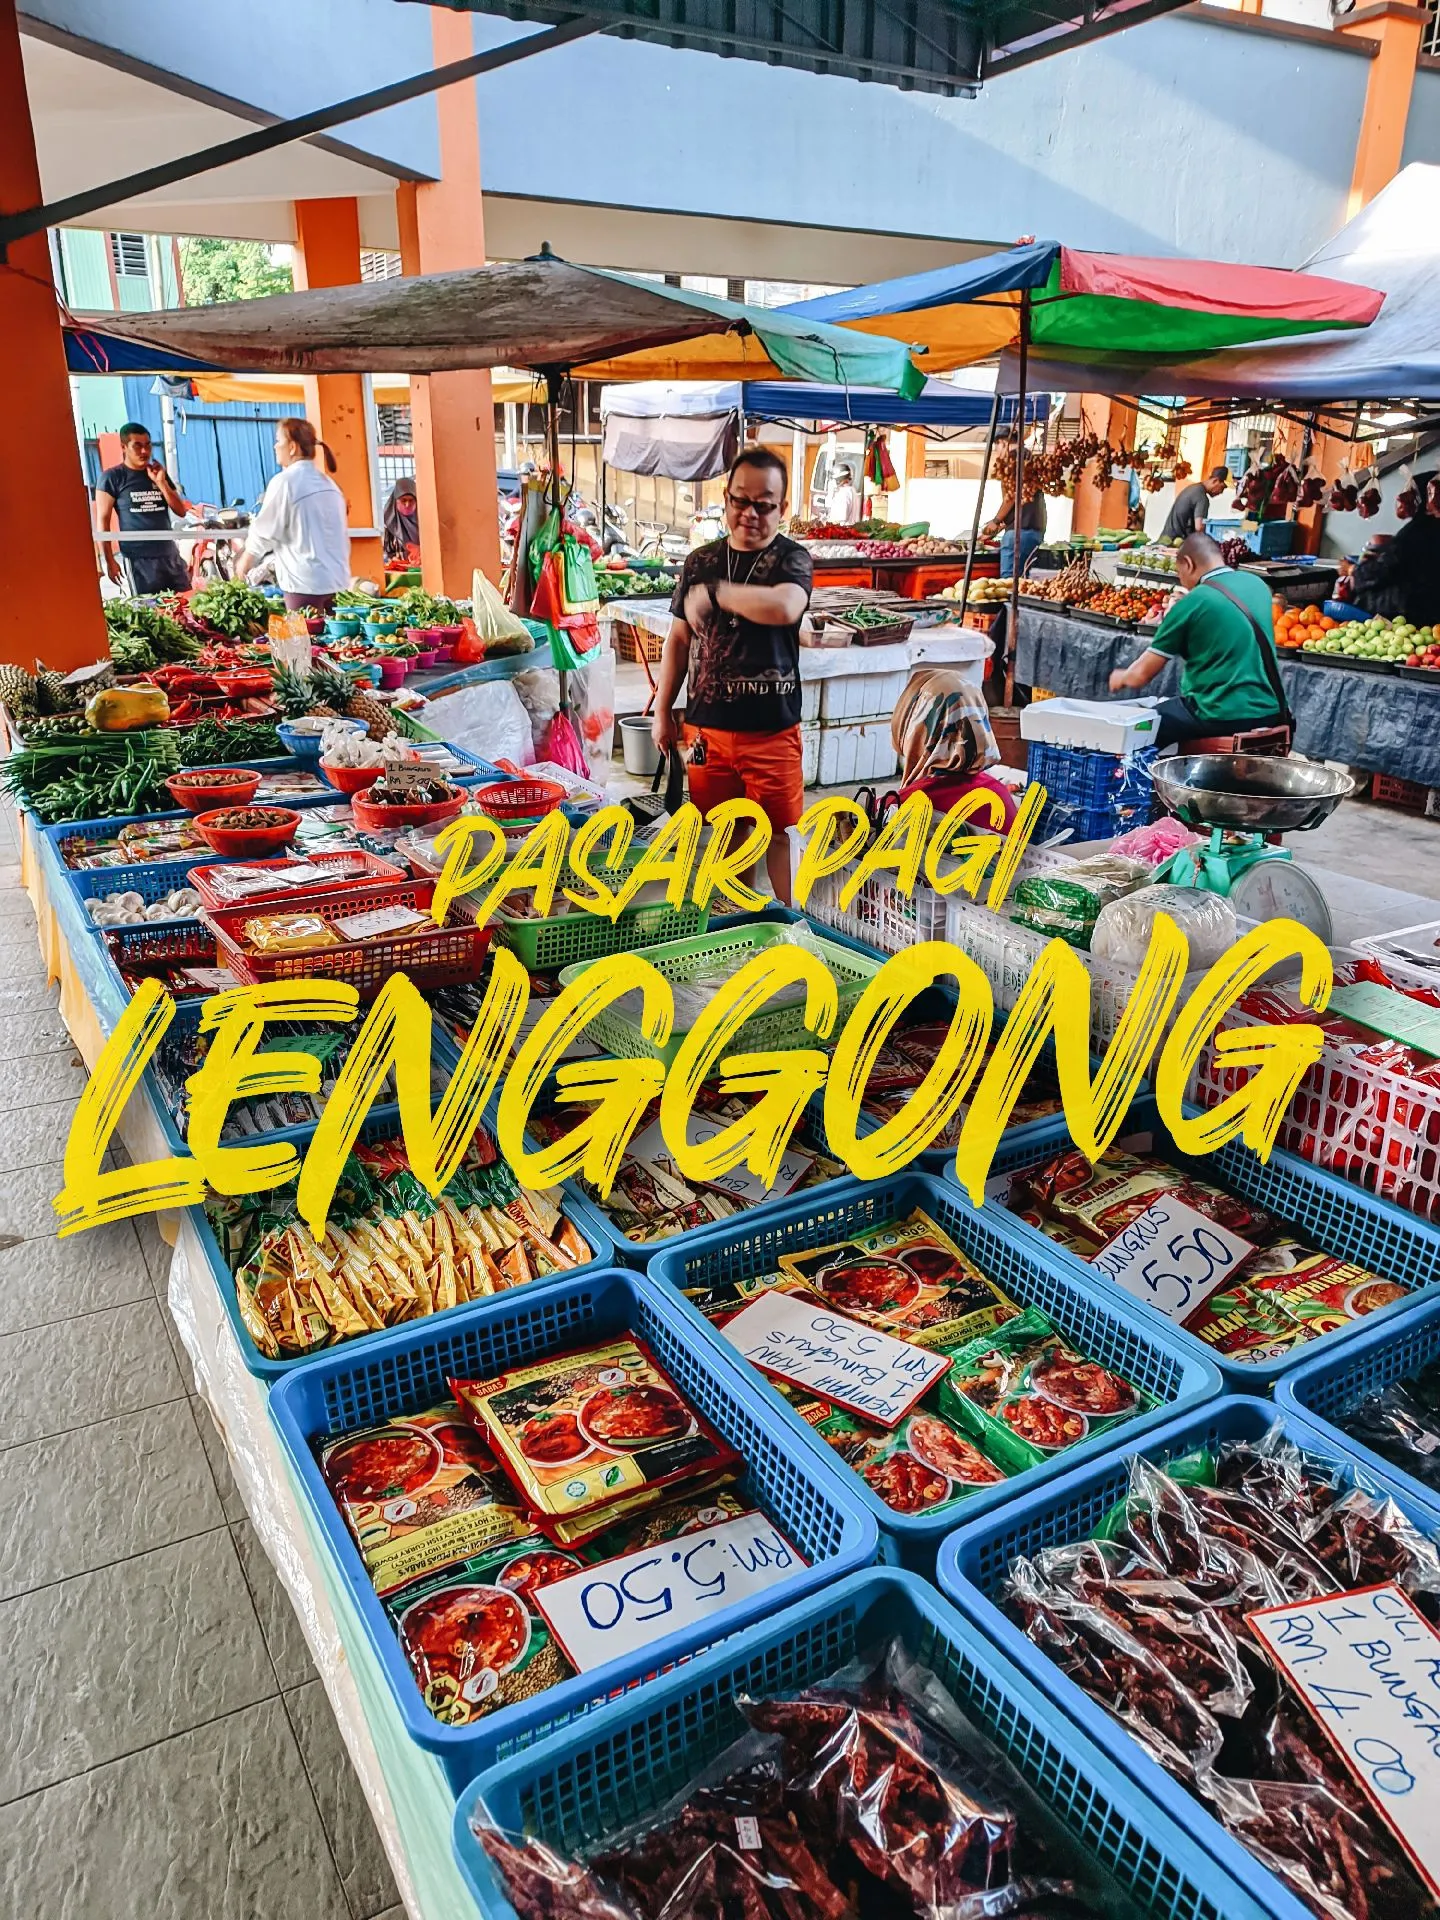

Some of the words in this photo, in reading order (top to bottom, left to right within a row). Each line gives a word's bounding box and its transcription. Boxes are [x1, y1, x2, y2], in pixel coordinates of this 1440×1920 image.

[1141, 1227, 1234, 1308] 5.50
[810, 1316, 877, 1355] 5.50
[1198, 1309, 1250, 1343] IKAN
[744, 1346, 811, 1375] IKAN
[476, 1381, 504, 1396] BABAS
[813, 1375, 899, 1416] REMPAH
[580, 1538, 726, 1630] 5.50
[1318, 1606, 1367, 1635] 1
[1307, 1682, 1416, 1795] 4.00
